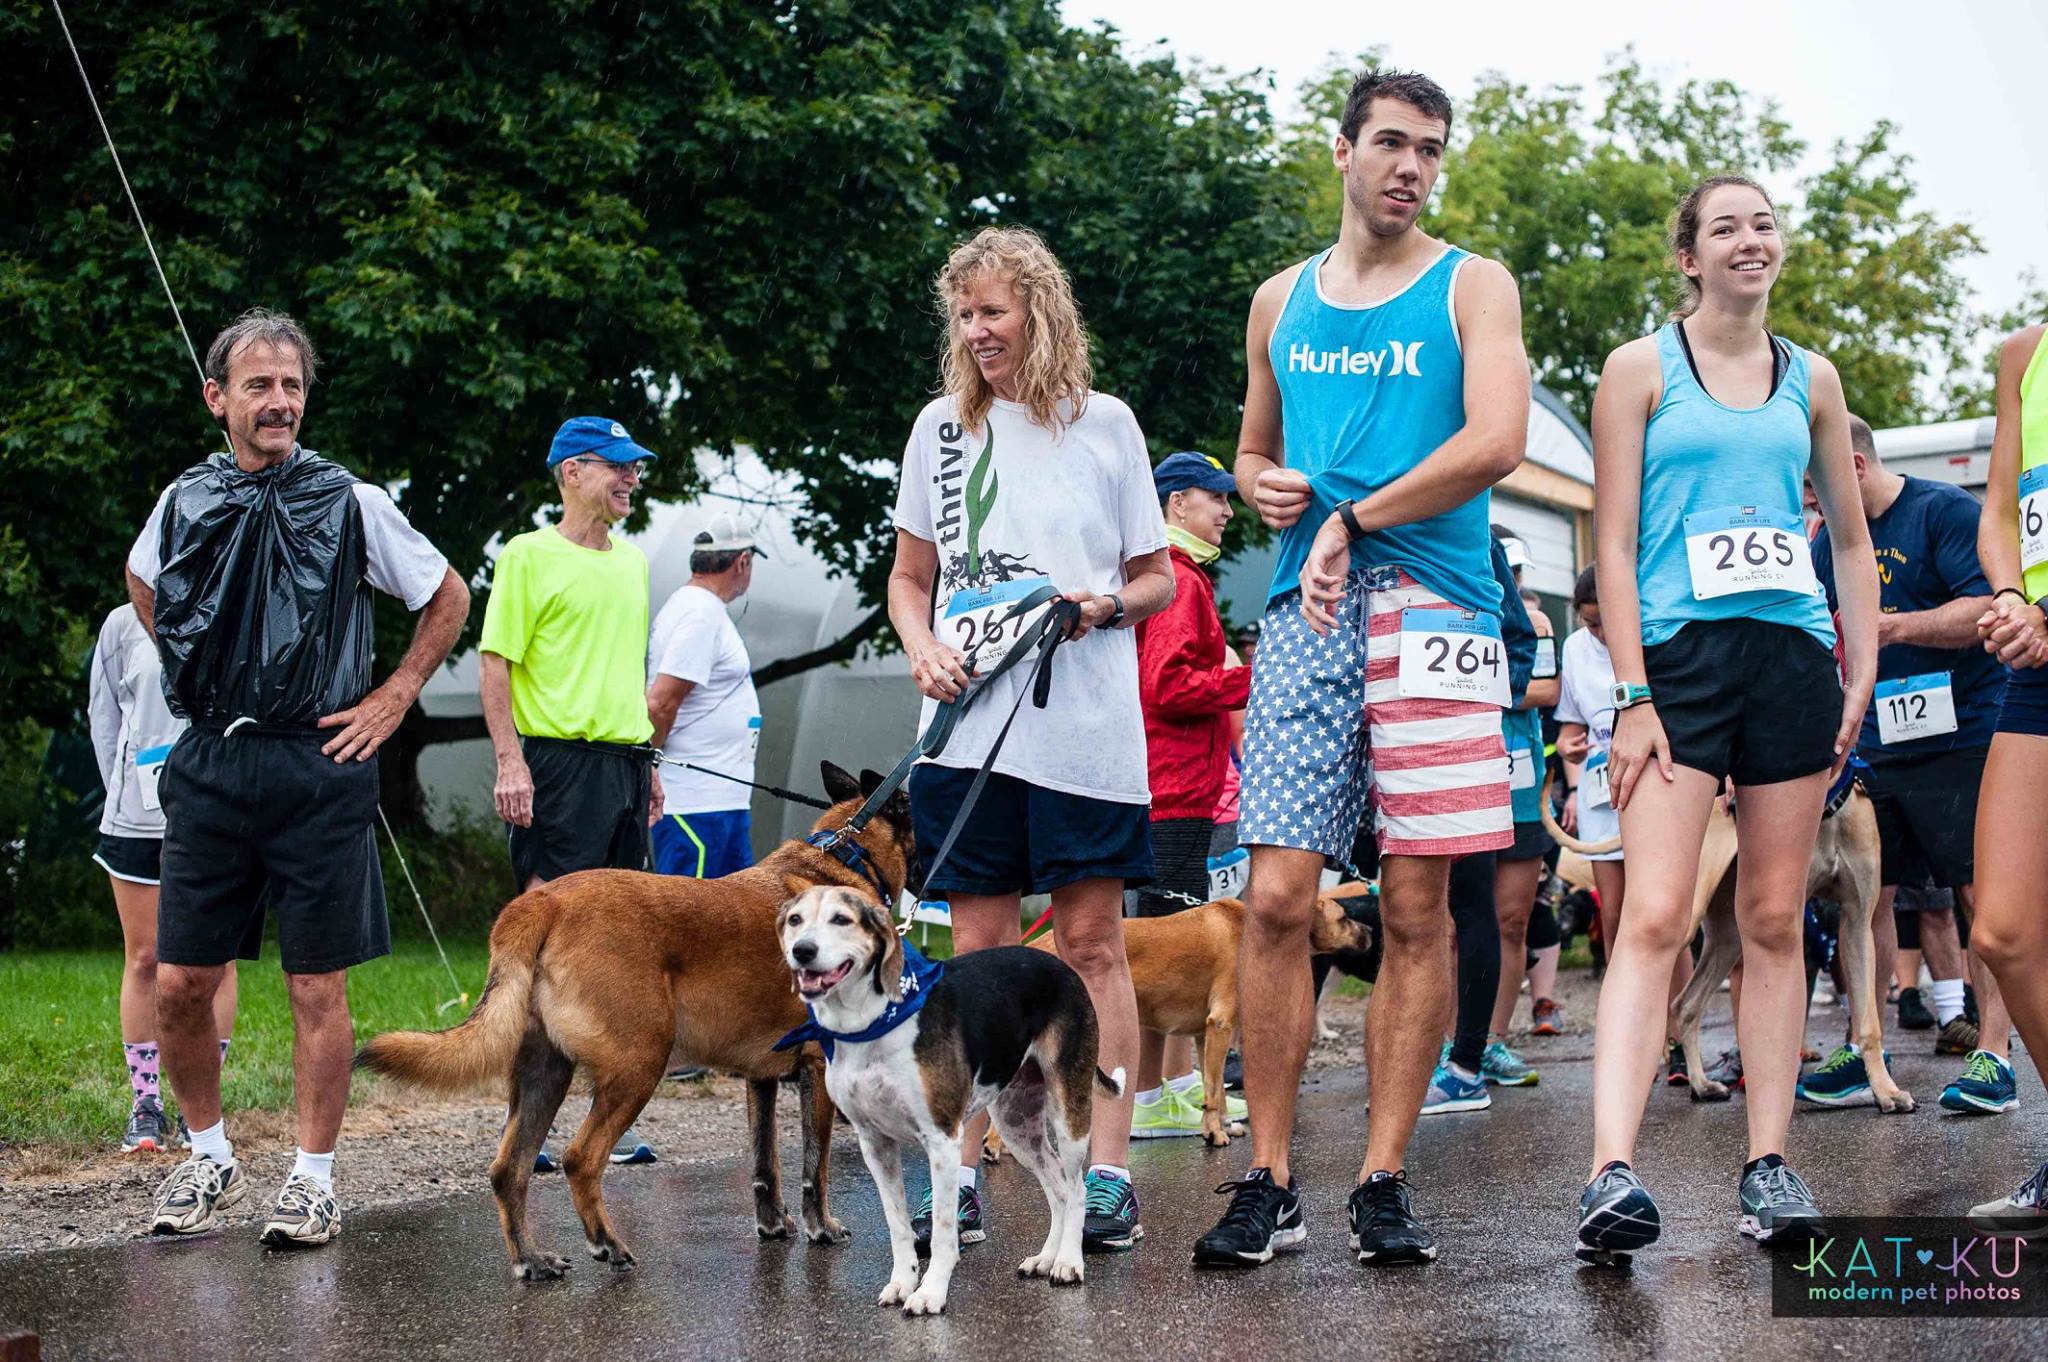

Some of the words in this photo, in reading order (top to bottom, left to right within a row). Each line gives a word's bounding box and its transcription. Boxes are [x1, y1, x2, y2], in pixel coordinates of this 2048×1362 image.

[1288, 343, 1388, 377] Hurley
[933, 421, 963, 547] thrive
[1709, 531, 1793, 570] 265
[1733, 573, 1773, 582] RUNNING
[1425, 636, 1500, 678] 264
[1439, 681, 1477, 690] RUNNING
[1889, 694, 1927, 724] 112
